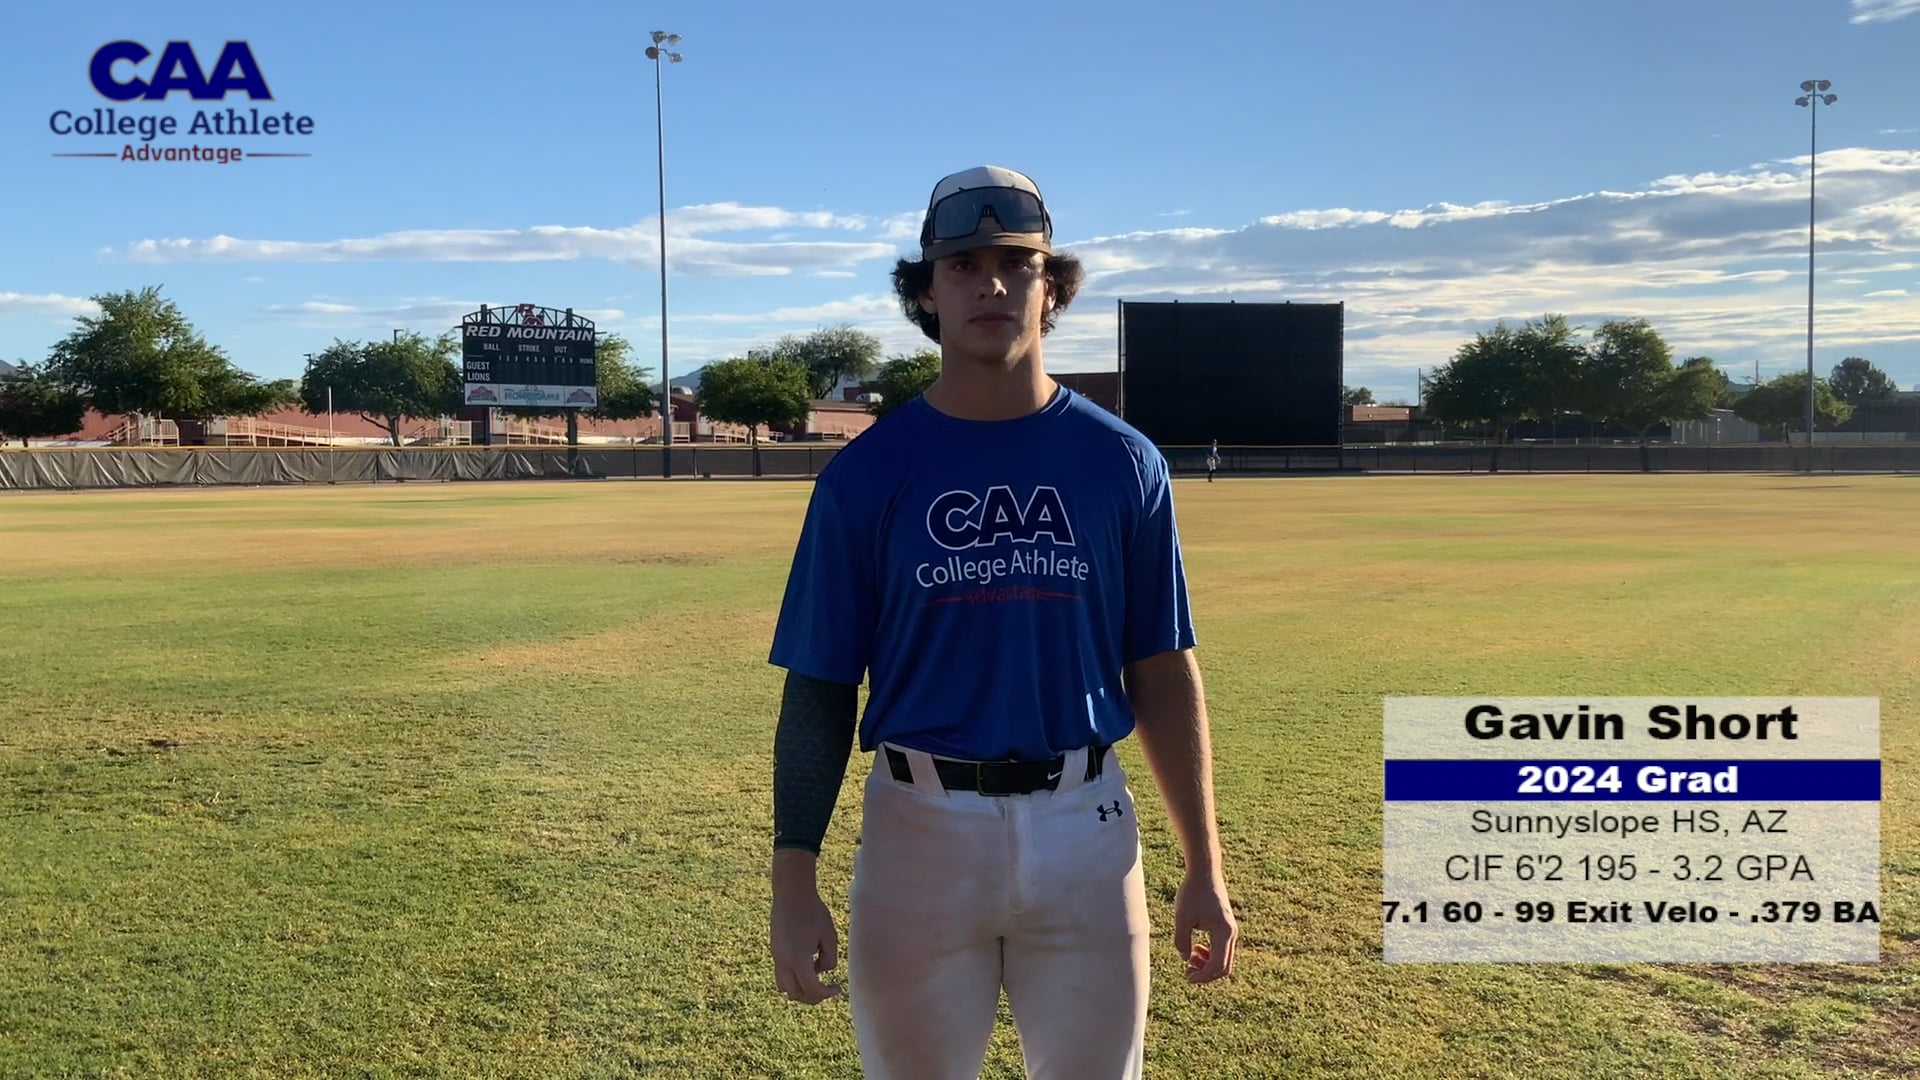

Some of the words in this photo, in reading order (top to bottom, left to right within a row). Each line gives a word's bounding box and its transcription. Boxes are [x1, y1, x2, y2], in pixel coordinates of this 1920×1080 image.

[466, 325, 501, 337] RED
[507, 327, 593, 341] MOUNTAIN
[483, 343, 500, 351] BALL
[518, 344, 540, 353] STRIKE
[554, 345, 567, 353] OUT
[466, 361, 490, 371] GUEST
[467, 371, 491, 382] LIONS
[926, 485, 1077, 551] CAA
[916, 555, 1007, 588] College
[1010, 549, 1090, 581] Athlete
